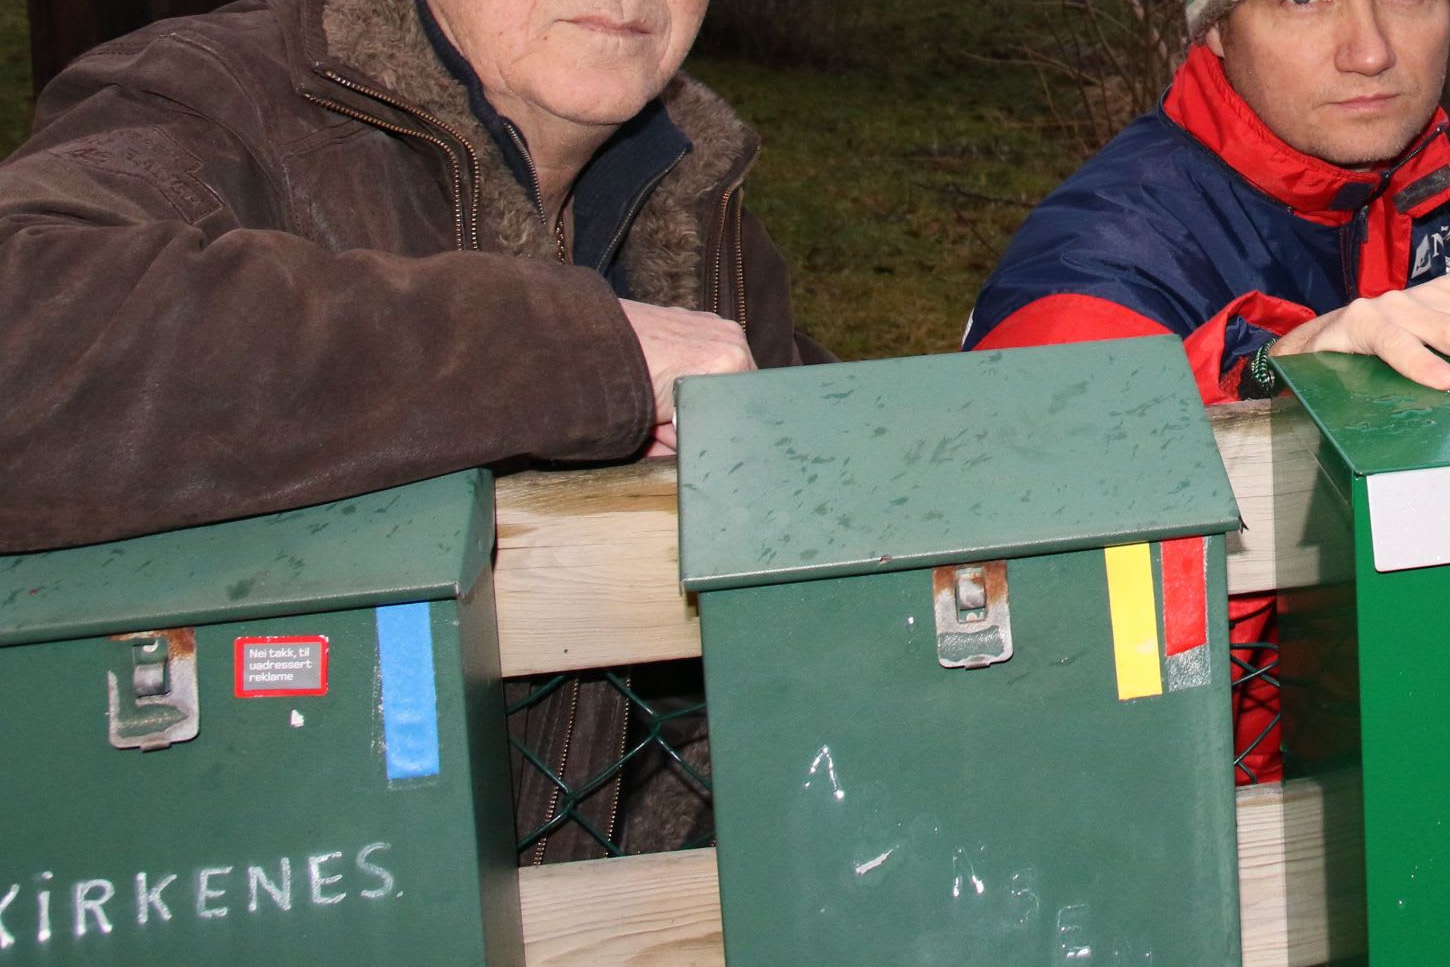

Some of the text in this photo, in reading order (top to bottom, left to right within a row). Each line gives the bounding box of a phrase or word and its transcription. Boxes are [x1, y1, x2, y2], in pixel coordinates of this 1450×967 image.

[248, 647, 310, 659] Nei takk, til
[248, 659, 313, 671] uadressert
[248, 671, 294, 682] reklame
